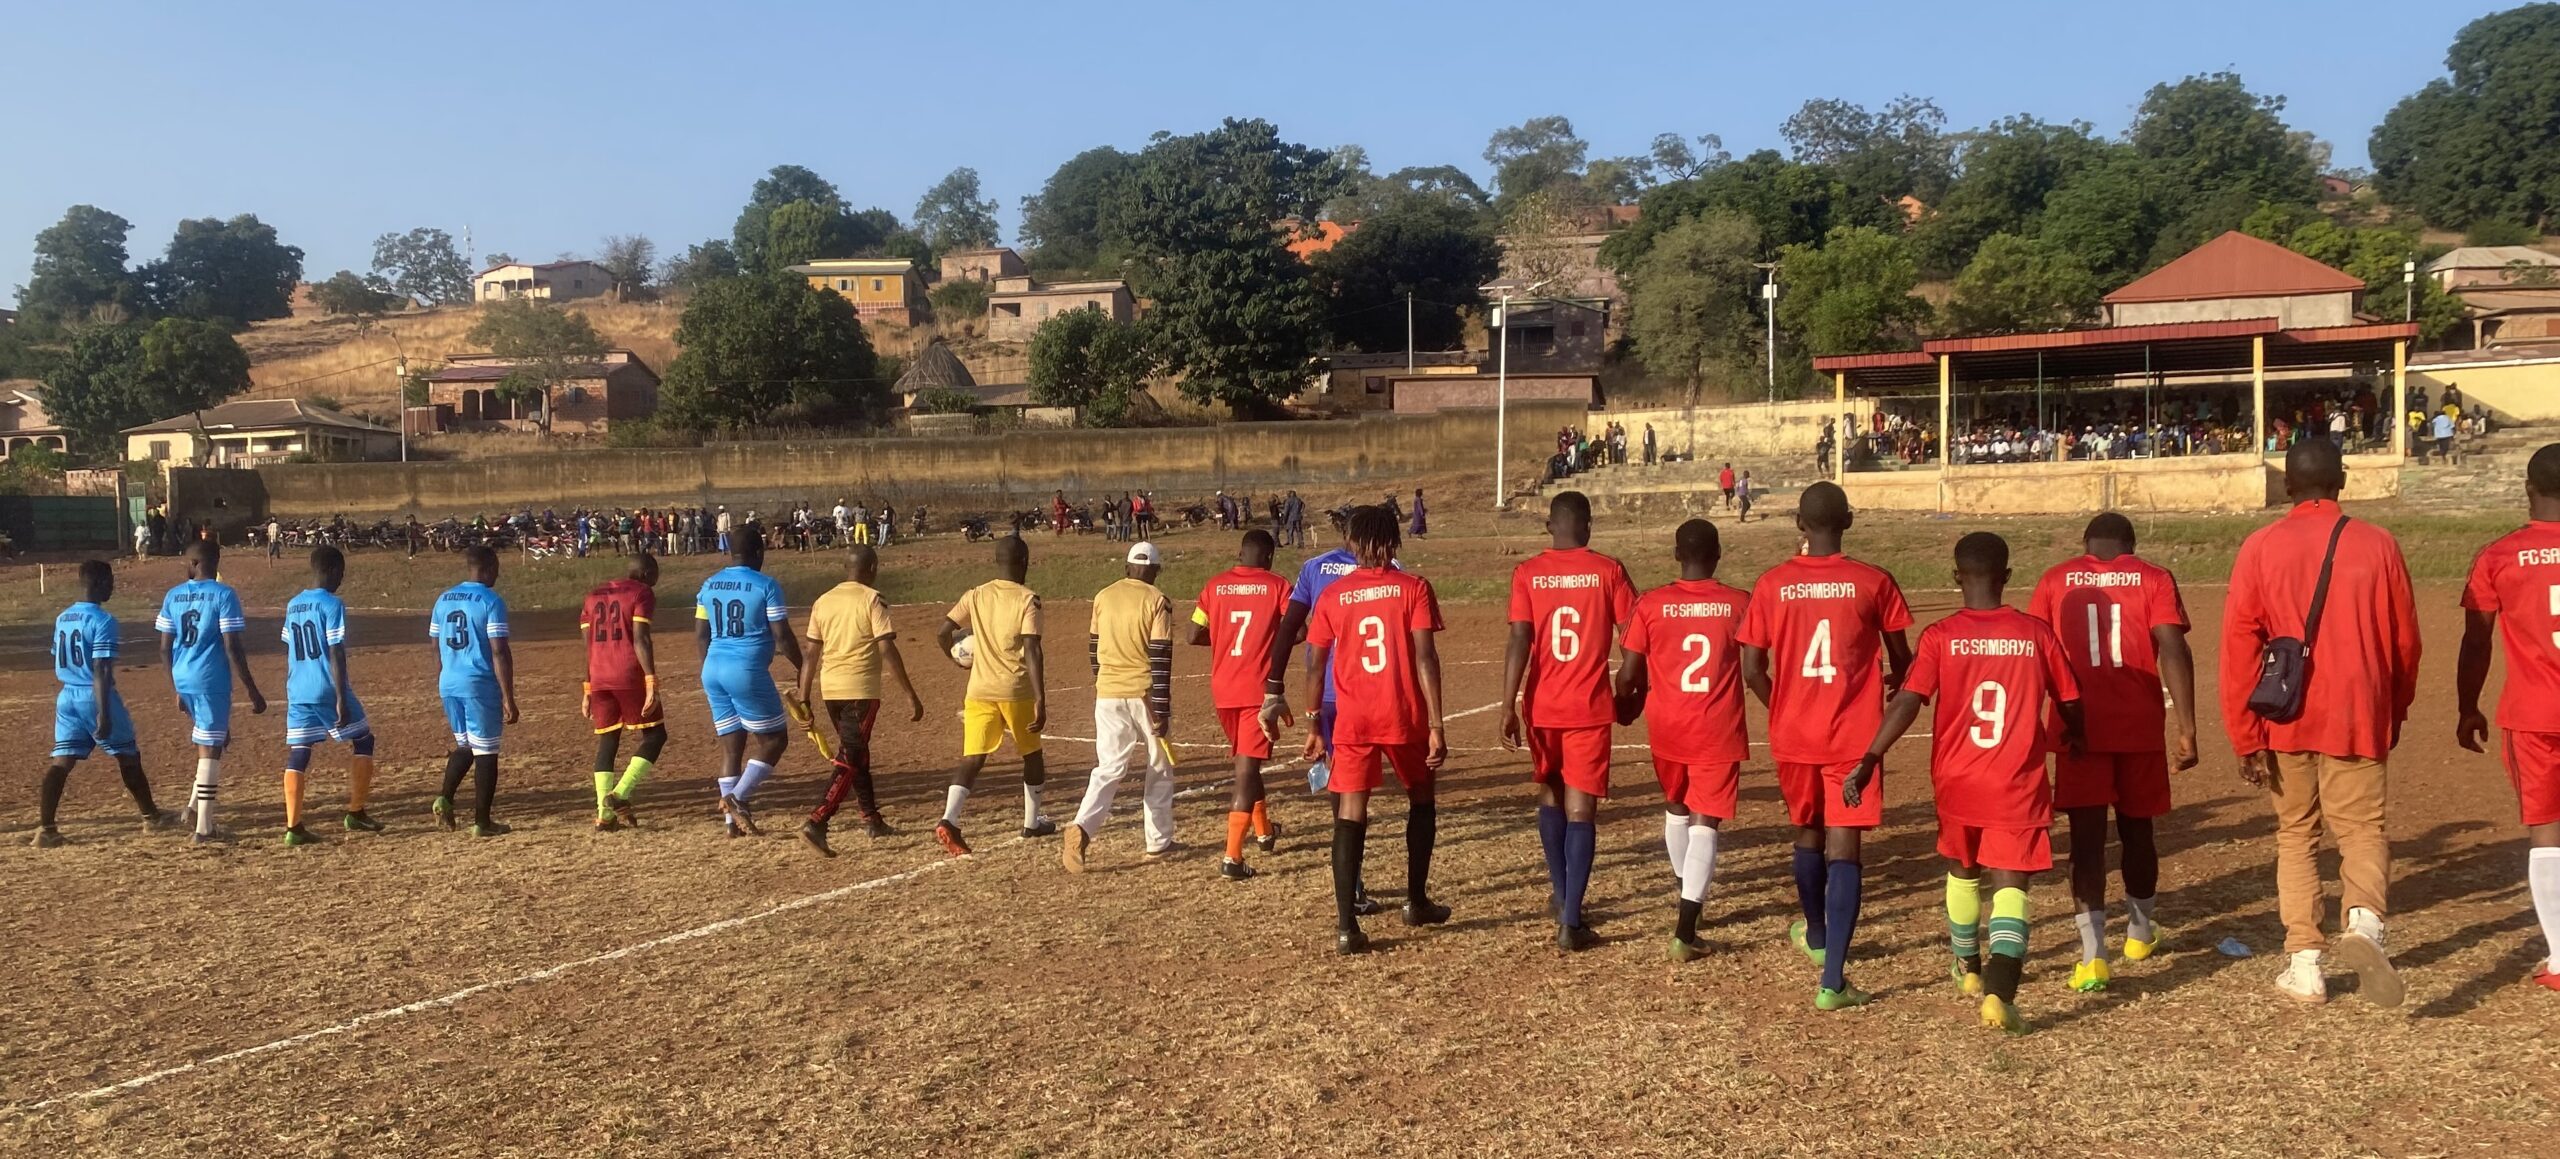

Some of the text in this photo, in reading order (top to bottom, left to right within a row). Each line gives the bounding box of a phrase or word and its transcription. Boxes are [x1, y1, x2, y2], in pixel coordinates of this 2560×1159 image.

[709, 581, 741, 591] KOUBIA
[181, 609, 200, 647] 6
[446, 610, 469, 650] 3
[594, 600, 622, 642] 22
[712, 598, 745, 637] 18
[1230, 611, 1252, 656] 7
[1552, 606, 1580, 662] 6
[2087, 603, 2122, 667] 11
[59, 629, 84, 668] 16
[291, 620, 322, 661] 10
[1358, 616, 1387, 673] 3
[1802, 619, 1837, 683] 4
[1681, 633, 1711, 692] 2
[1970, 680, 2007, 749] 9
